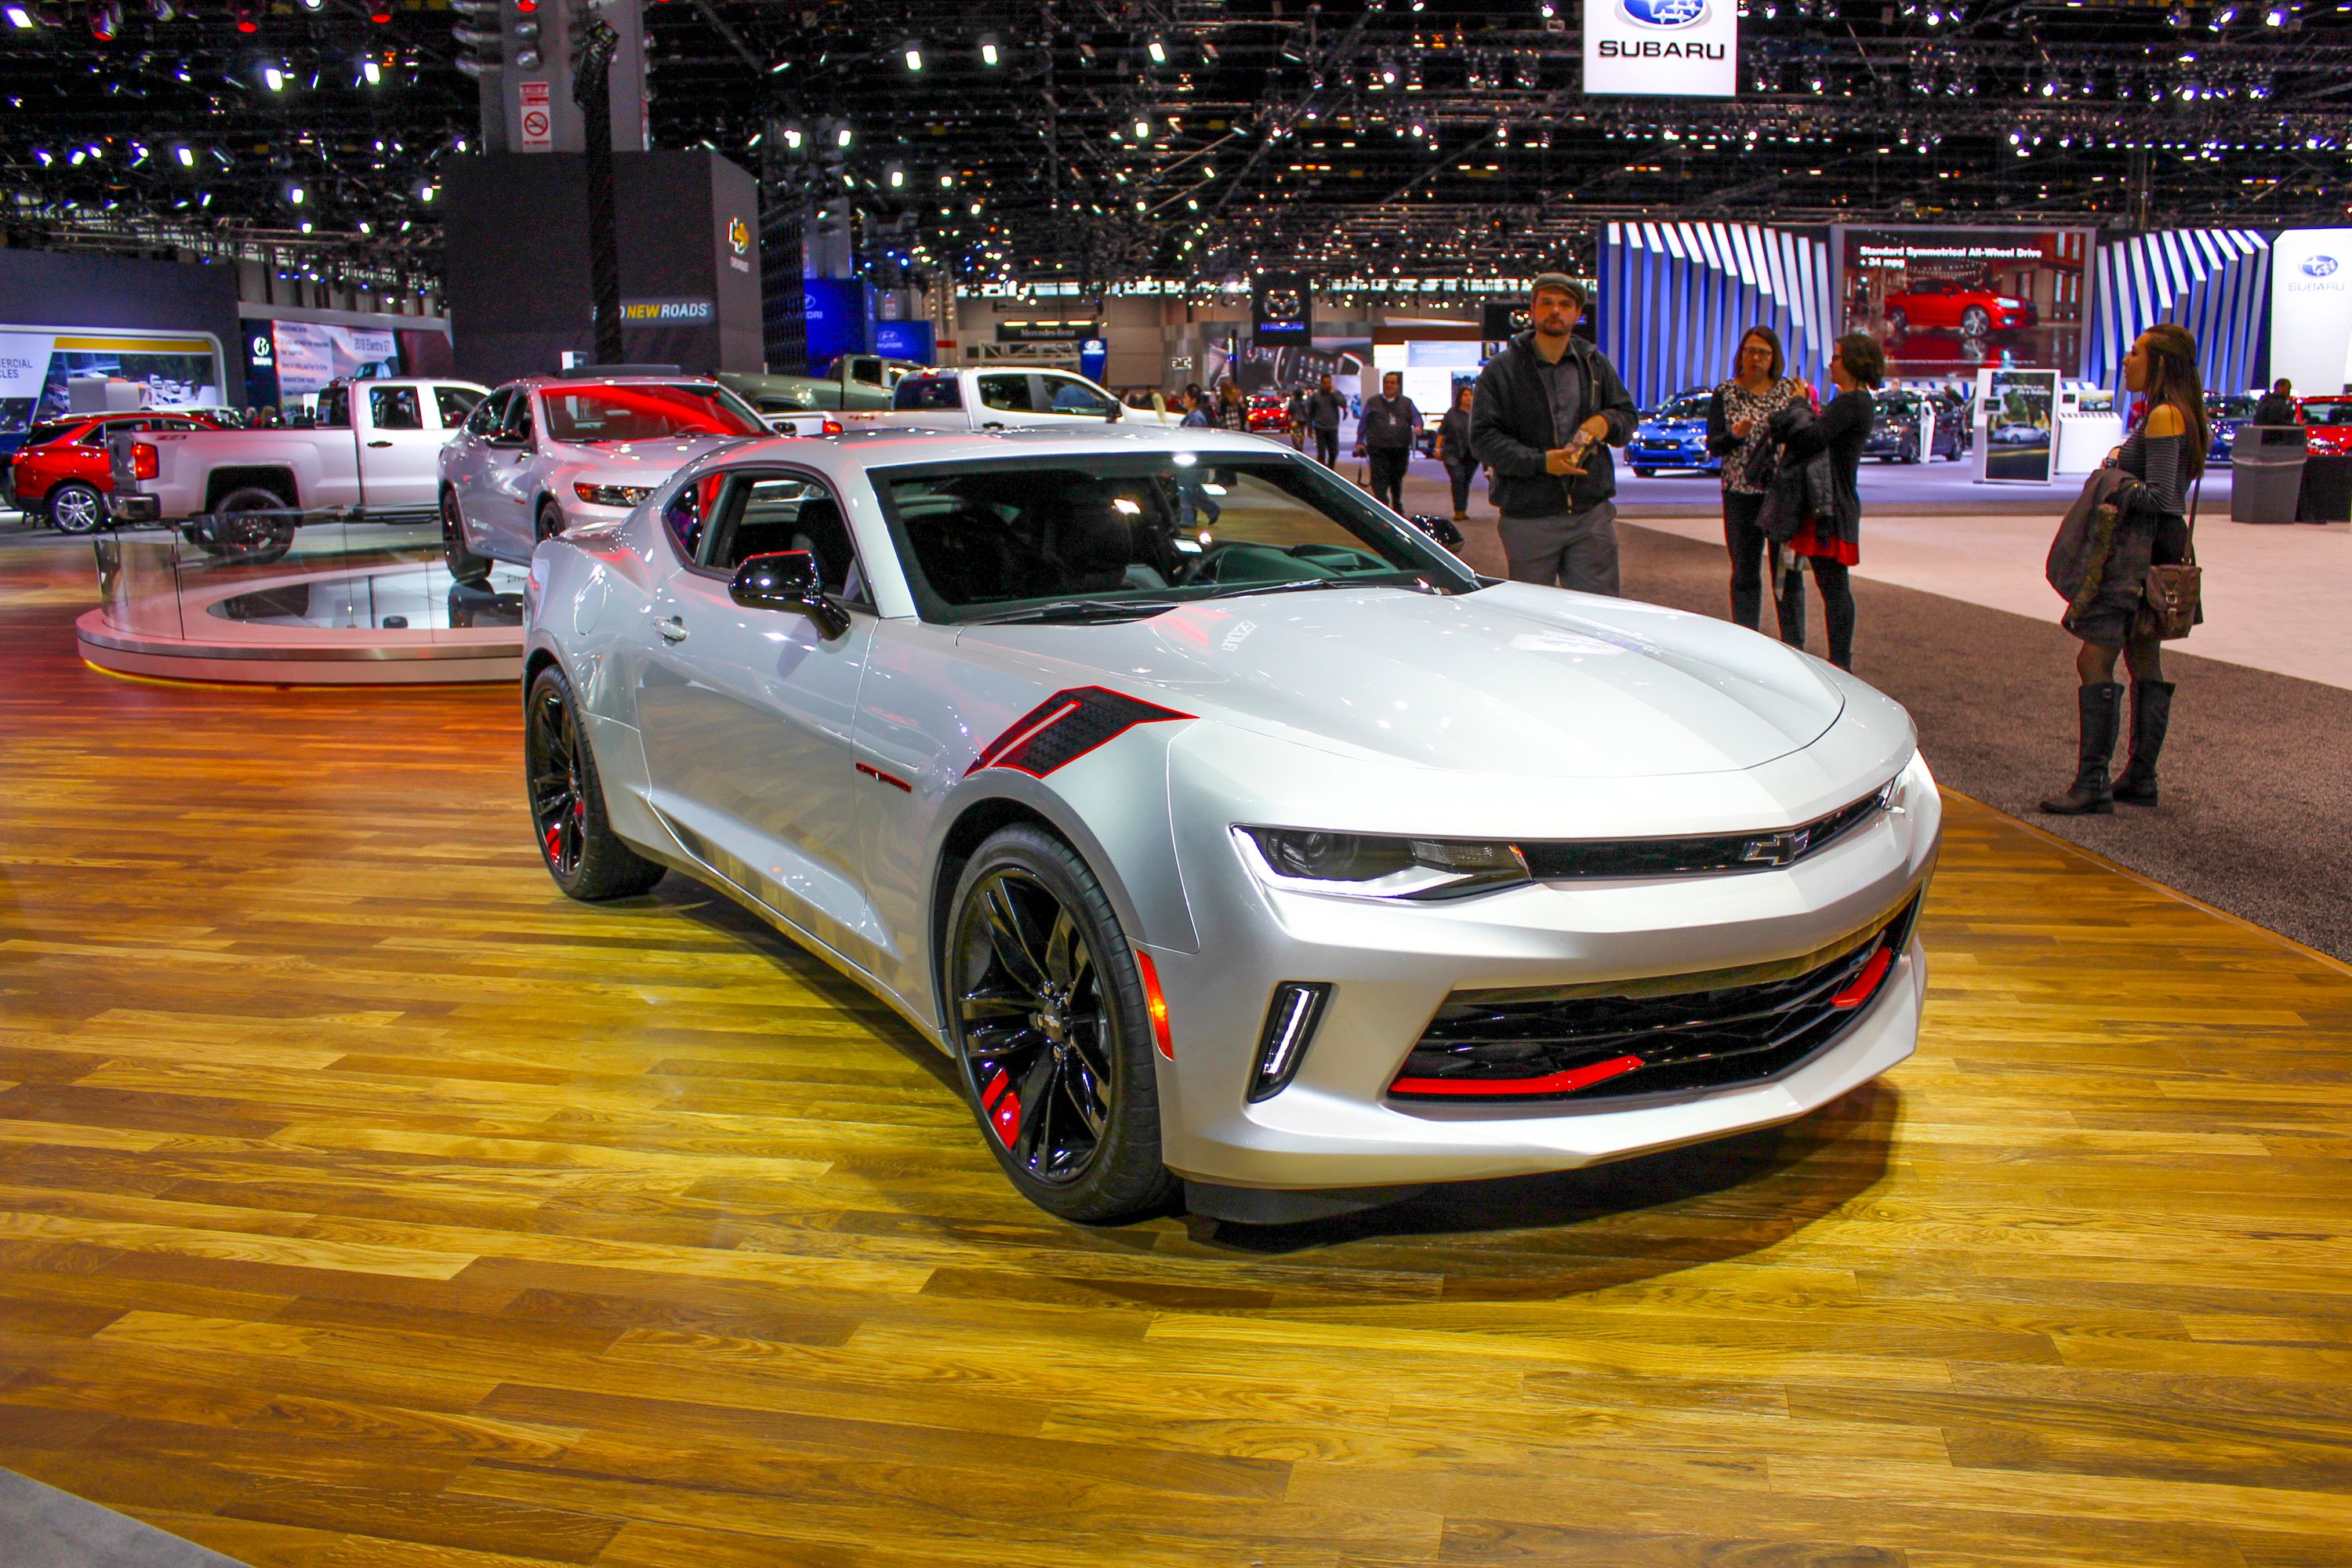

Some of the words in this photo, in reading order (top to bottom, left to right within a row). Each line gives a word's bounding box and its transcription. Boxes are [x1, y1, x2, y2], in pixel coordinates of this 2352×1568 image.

[1599, 40, 1725, 60] SUBARU
[1860, 246, 1904, 256] Standard
[1906, 246, 1966, 258] Symmetrical
[1968, 248, 2014, 257] All-Wheel
[2016, 248, 2042, 258] Drive
[1883, 259, 1905, 268] mpg
[2288, 282, 2344, 291] SUBARU
[627, 304, 659, 318] NEW
[661, 303, 707, 318] ROADS
[0, 358, 33, 368] ERCIAL
